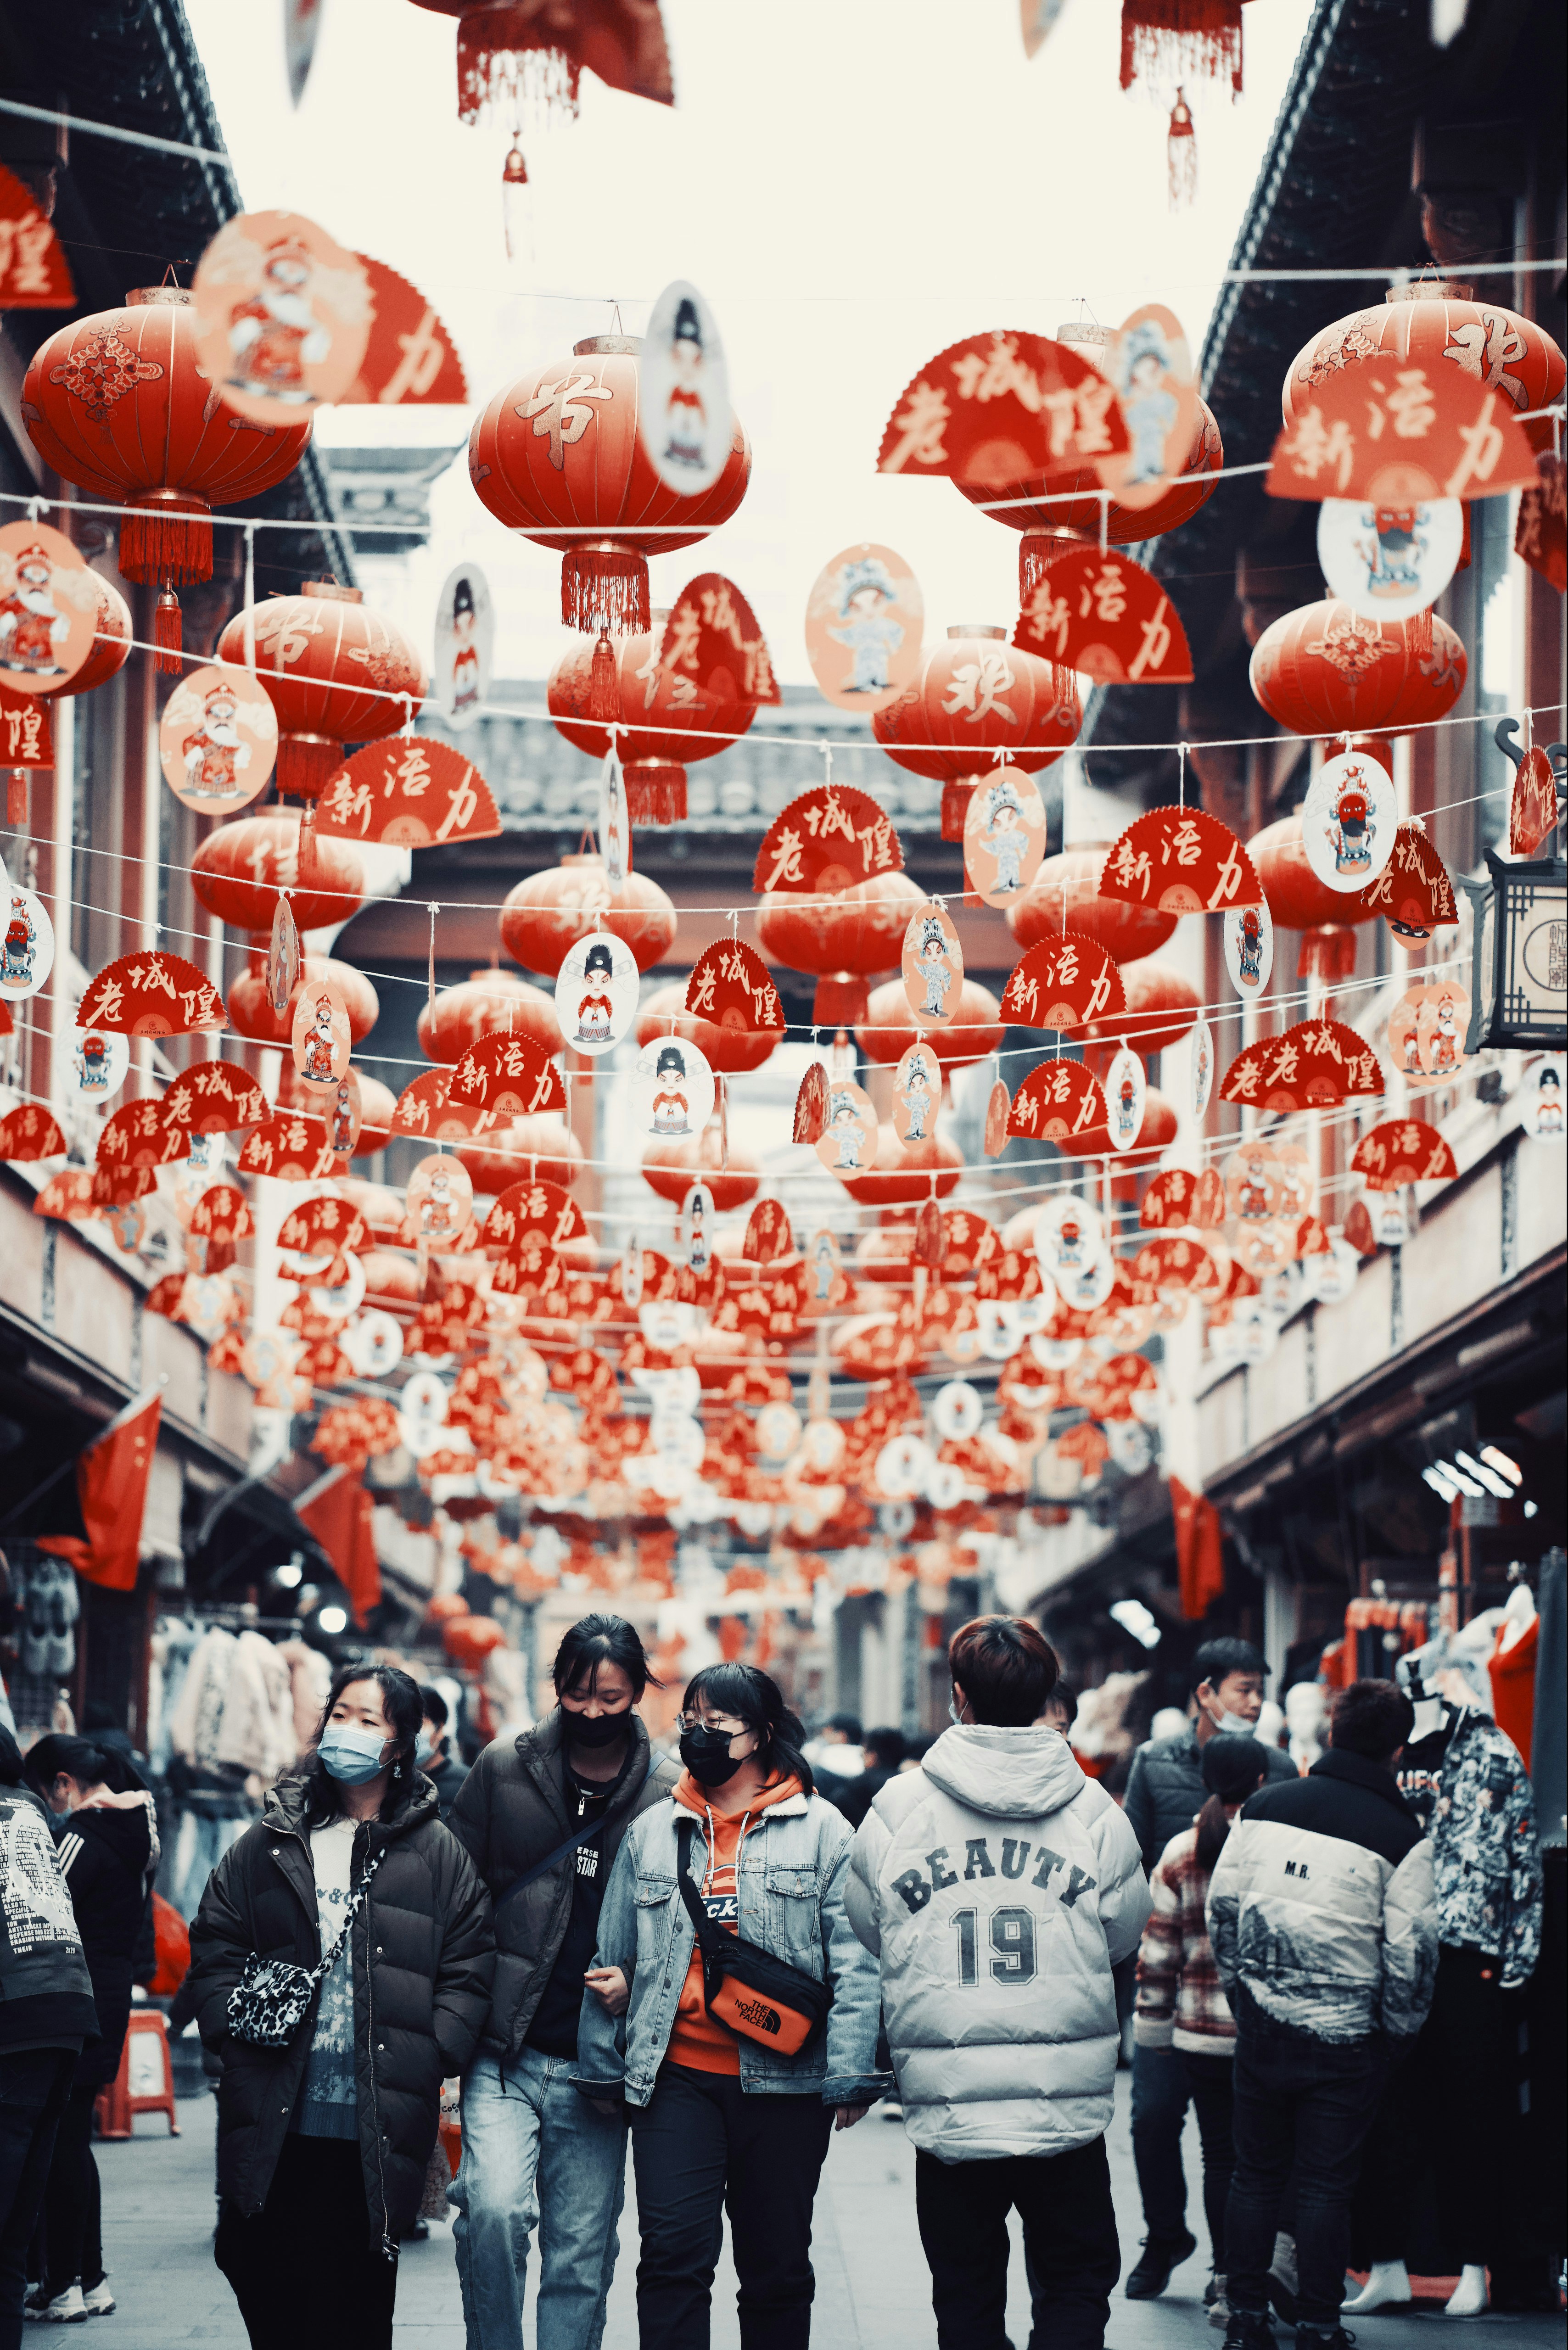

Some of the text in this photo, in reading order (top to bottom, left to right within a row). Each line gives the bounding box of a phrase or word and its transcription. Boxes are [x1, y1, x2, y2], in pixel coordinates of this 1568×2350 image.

[1285, 369, 1504, 497] 新活力
[1023, 565, 1170, 680] 新活力
[324, 747, 478, 841] 新活力
[764, 793, 894, 893] 老城隍
[1109, 821, 1243, 910] 新活力
[1368, 834, 1451, 917] 老城隍
[86, 956, 218, 1028] 老城隍
[691, 945, 778, 1026] 老城隍
[1007, 944, 1113, 1022] 新活力
[459, 1041, 553, 1104] 新活力
[1265, 1024, 1376, 1089] 老城隍
[163, 1066, 265, 1128] 老城隍
[1011, 1067, 1097, 1134] 新活力
[101, 1104, 182, 1163] 新活力
[245, 1120, 336, 1179] 新活力
[487, 1187, 574, 1245] 新活力
[577, 1856, 598, 1877] STAR
[890, 1838, 1098, 1914] BEAUTY
[4, 1902, 18, 1910] ALSO
[9, 1930, 34, 1940] DEFENSE
[10, 1936, 34, 1946] ERASING
[13, 1945, 33, 1954] THEIR
[948, 1905, 1038, 1988] 19
[734, 1999, 767, 2020] NORTH
[739, 2010, 763, 2027] FACE
[752, 1999, 770, 2014] THE
